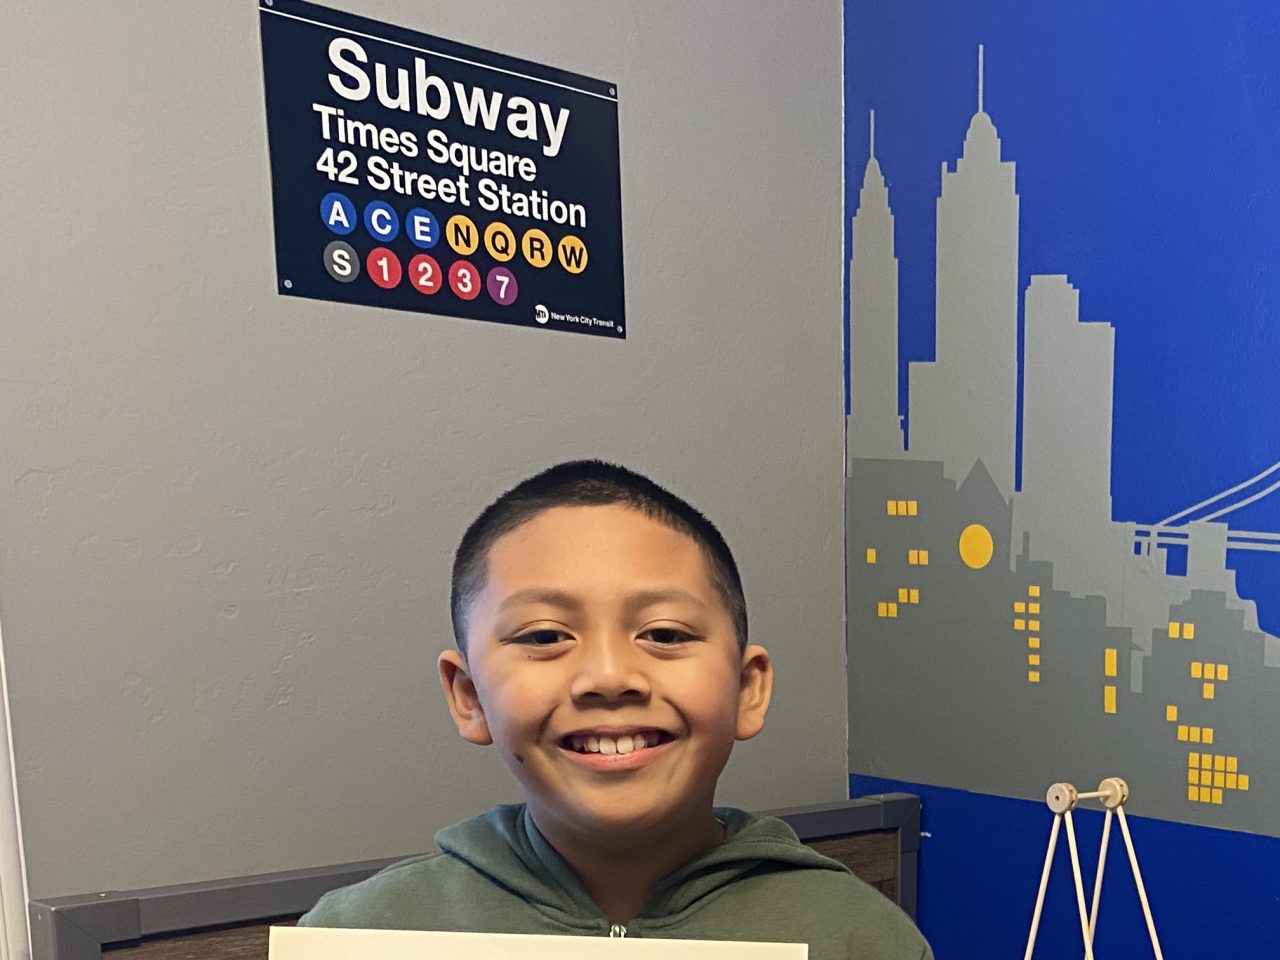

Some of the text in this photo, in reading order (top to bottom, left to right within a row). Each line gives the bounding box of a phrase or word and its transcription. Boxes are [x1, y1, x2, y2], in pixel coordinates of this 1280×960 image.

[328, 37, 570, 157] Subway
[312, 103, 537, 182] Times Square
[316, 148, 587, 228] 42 Street Station
[329, 201, 584, 269] A C E N Q R W
[332, 249, 510, 299] S 1 2 3 7
[551, 311, 614, 328] New York City Transit
